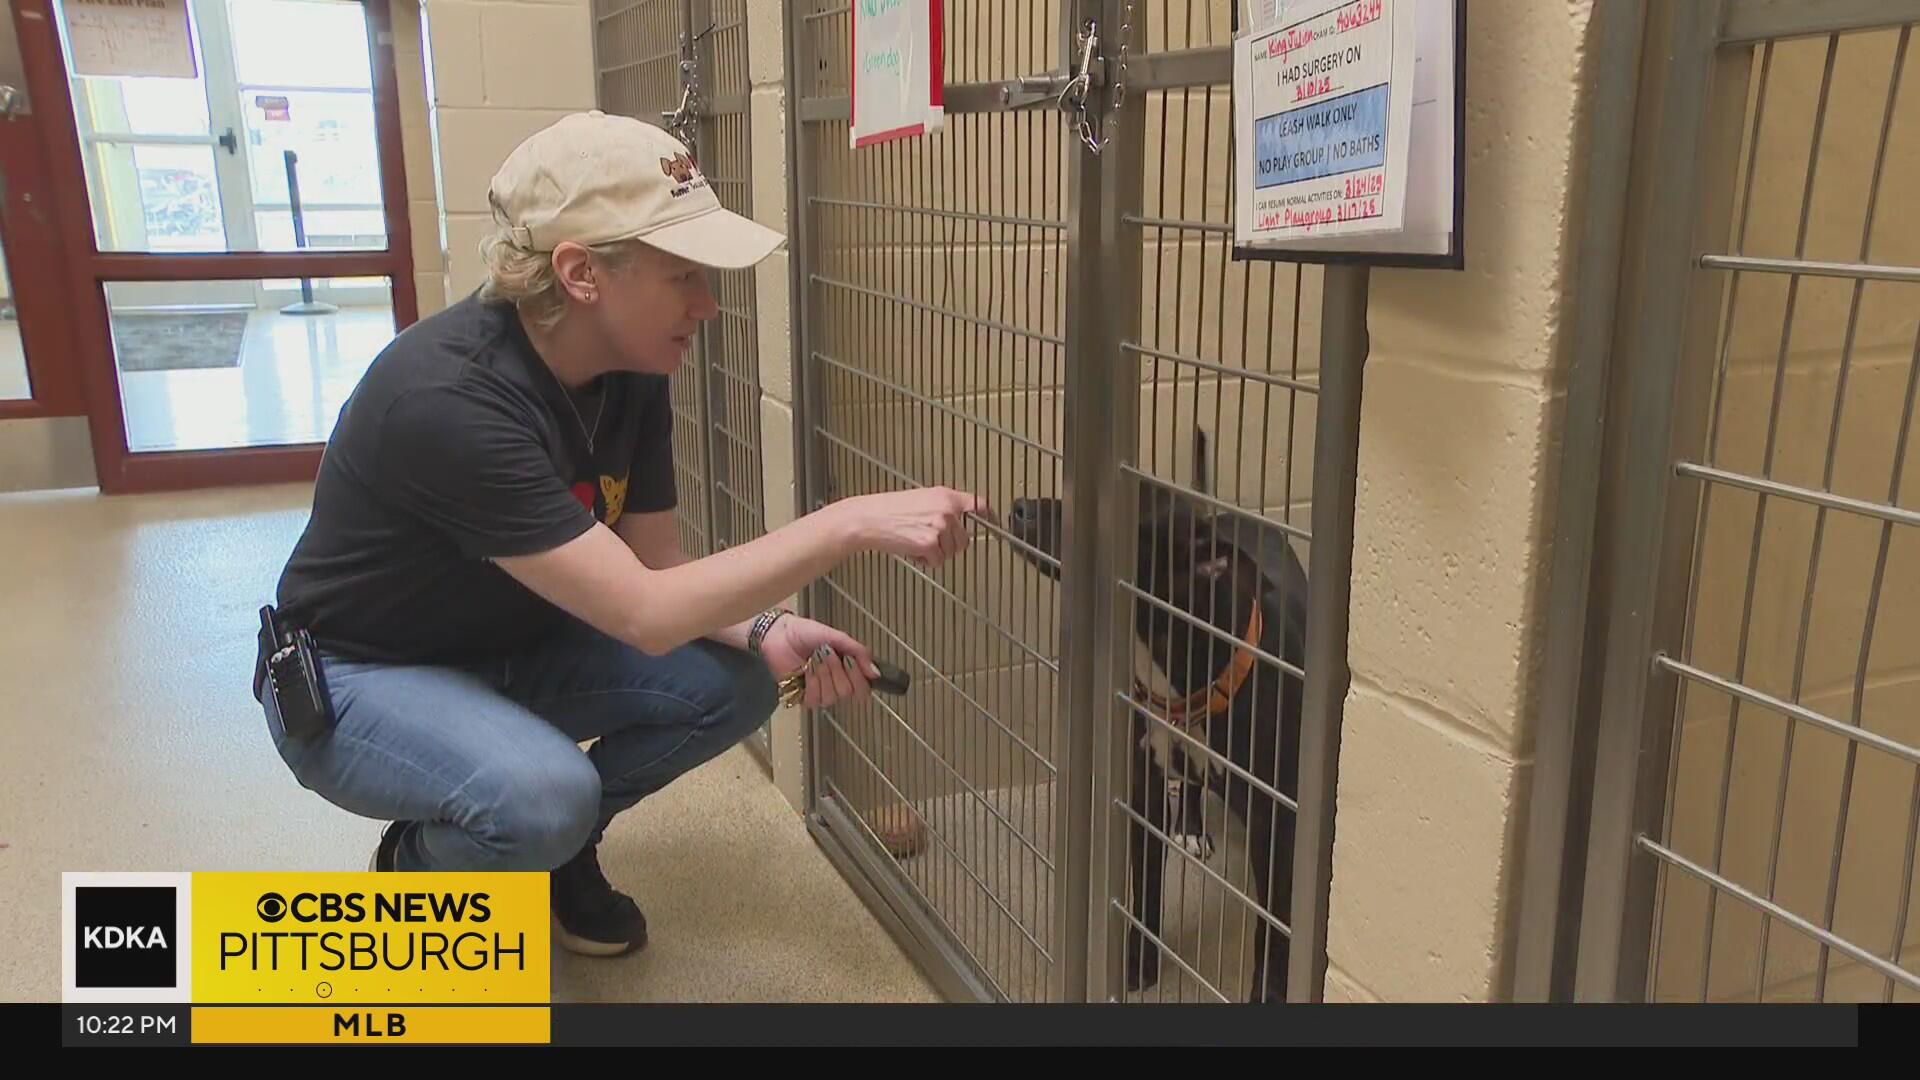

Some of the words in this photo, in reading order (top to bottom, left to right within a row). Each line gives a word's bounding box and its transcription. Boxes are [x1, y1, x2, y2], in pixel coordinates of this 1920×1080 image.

[1268, 37, 1287, 63] King
[1282, 65, 1300, 84] HAD
[1302, 52, 1343, 78] SURGERY
[1346, 44, 1361, 64] ON
[1280, 119, 1304, 137] LEASH
[1306, 110, 1332, 131] WALK
[1333, 102, 1357, 124] ONLY
[1259, 159, 1272, 174] NO
[1273, 155, 1292, 173] PLAY
[1293, 147, 1324, 168] GROUP
[1333, 141, 1348, 161] NO
[1350, 134, 1380, 157] BATHS
[1286, 194, 1307, 206] NORMAL
[1308, 190, 1333, 202] ACTIVITIES
[1258, 210, 1280, 231] Light
[1284, 207, 1332, 231] Playgroup
